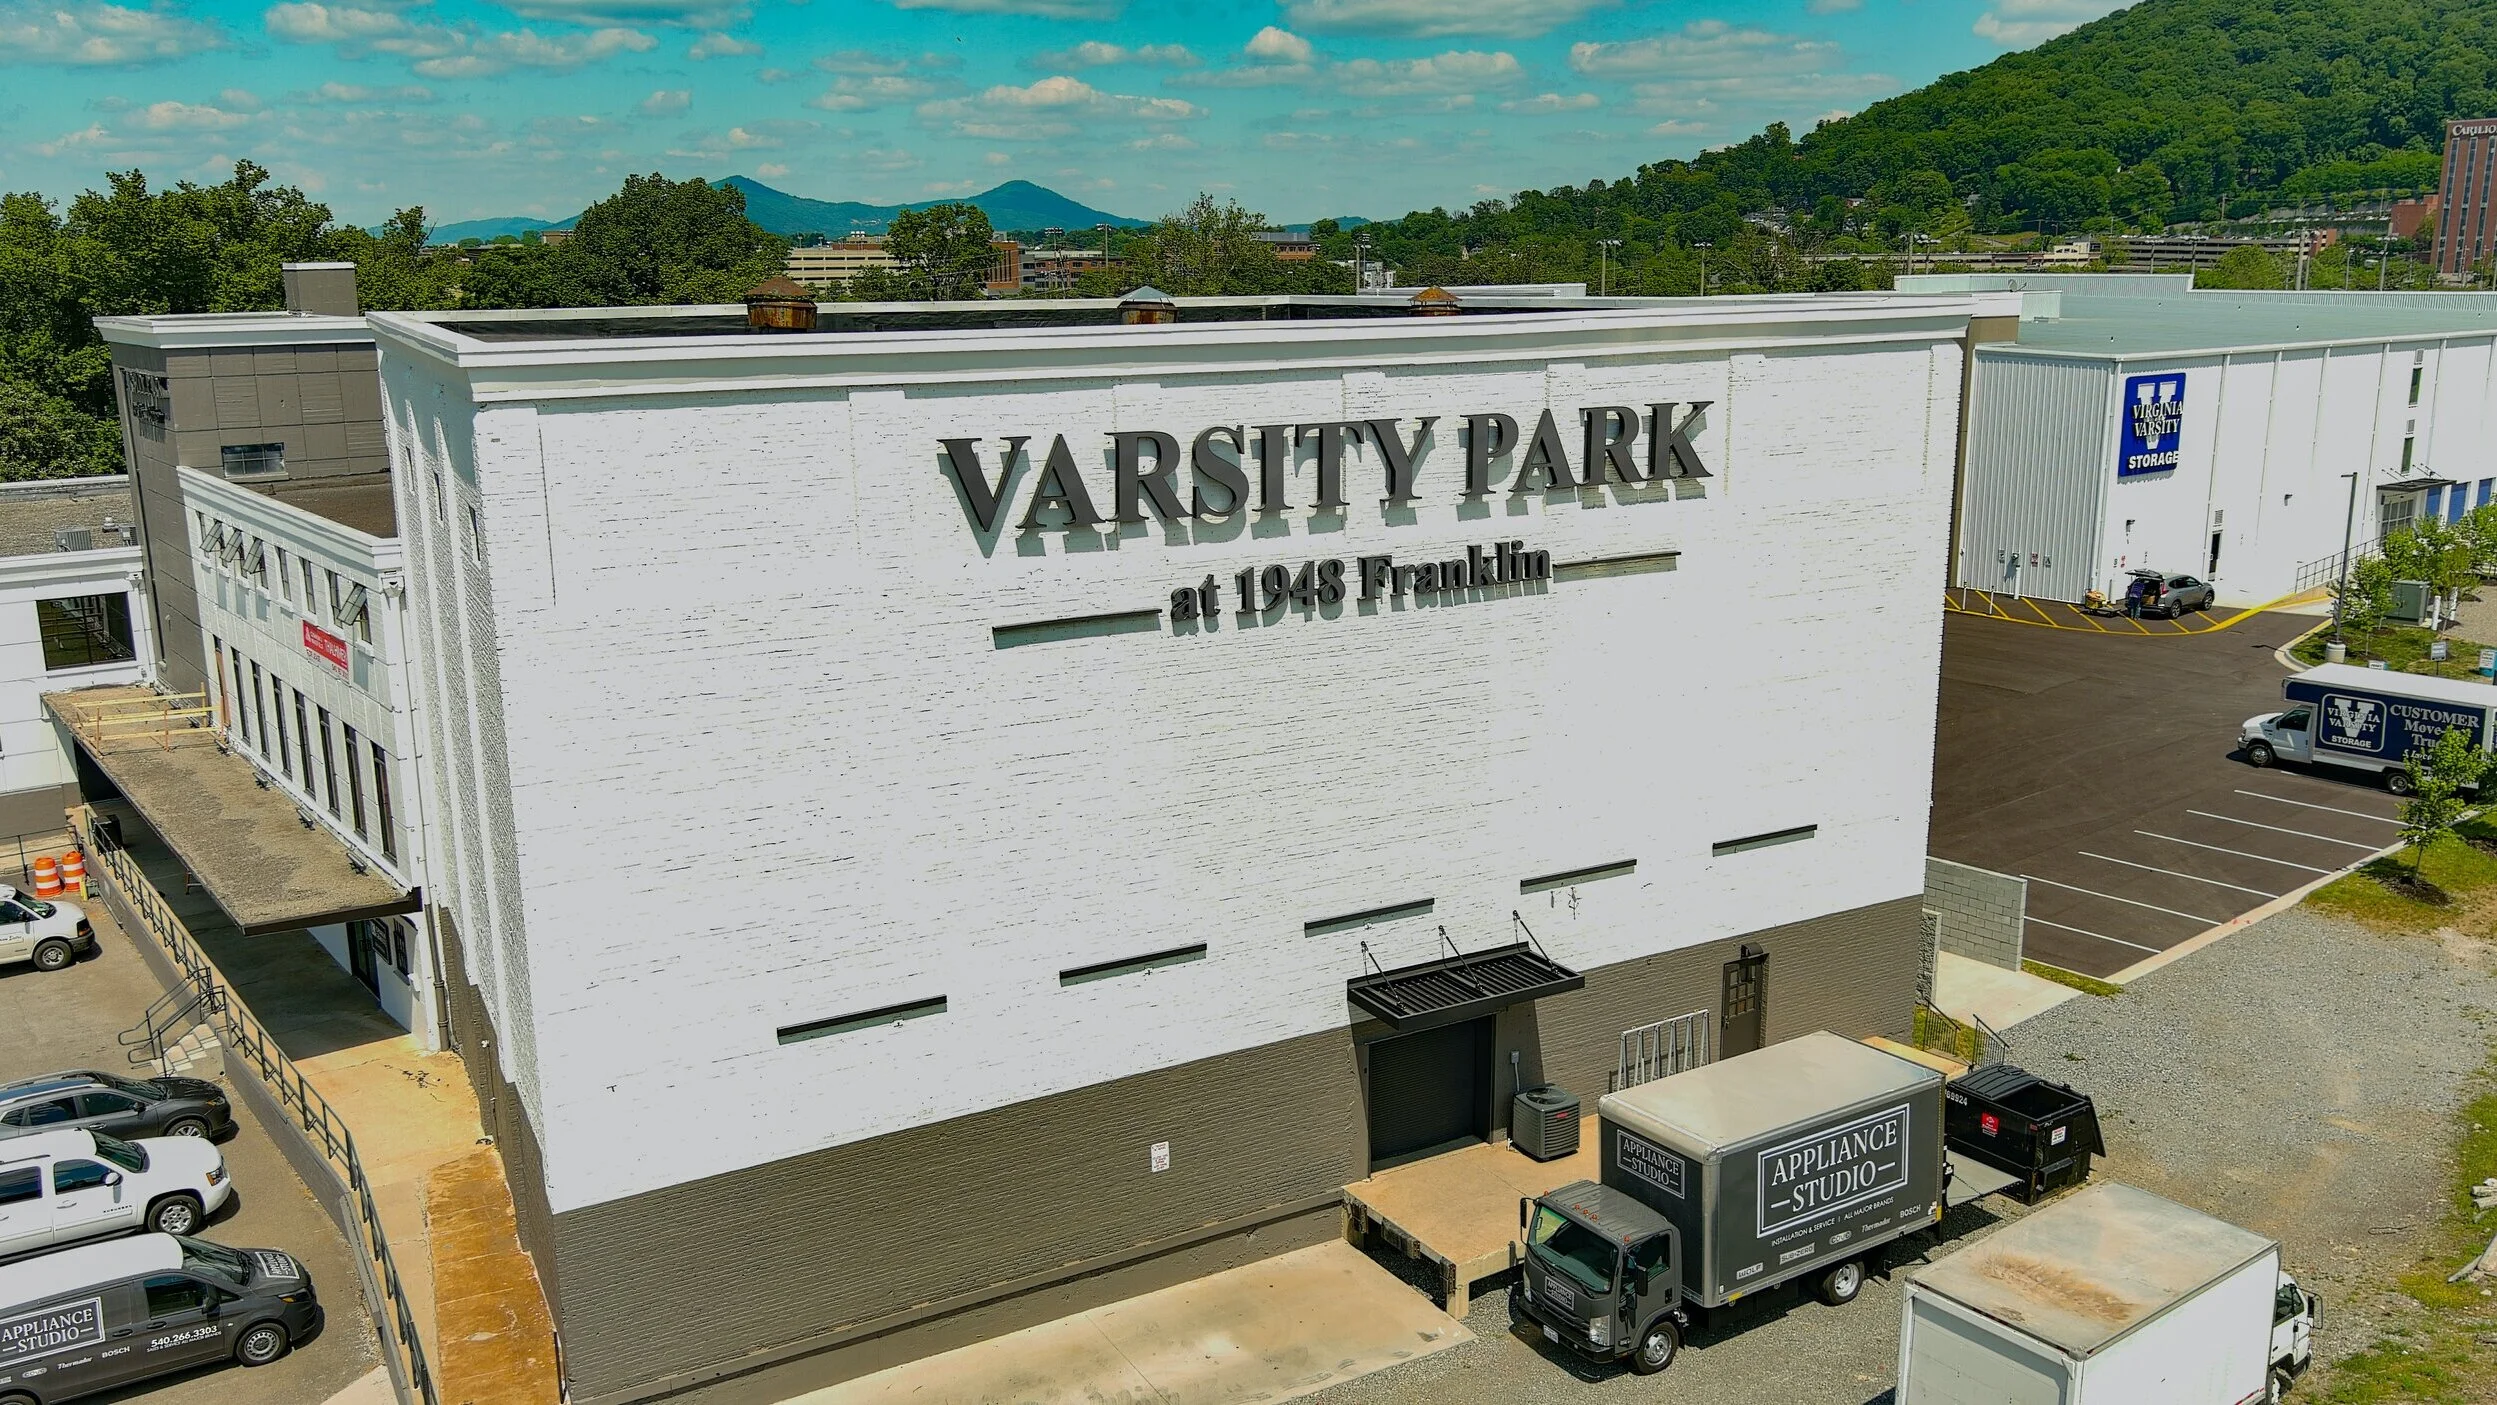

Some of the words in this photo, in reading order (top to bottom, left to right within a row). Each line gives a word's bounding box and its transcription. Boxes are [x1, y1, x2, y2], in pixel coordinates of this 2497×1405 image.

[2452, 124, 2497, 136] CARILIO
[2133, 400, 2183, 419] VIRGINIA
[2134, 419, 2180, 436] VARSITY
[936, 416, 1441, 533] VARSITY
[1460, 400, 1714, 497] PARK
[2128, 450, 2180, 469] STORAGE
[1170, 573, 1221, 621] at
[1235, 559, 1346, 614] 1948
[1357, 540, 1552, 601] Franklin
[2390, 704, 2480, 728] CUSTOMER
[2332, 735, 2372, 748] STORAGE
[1946, 1091, 1968, 1106] 69924
[1624, 1138, 1679, 1176] APPLIANCE
[1771, 1119, 1897, 1187] APPLIANCE
[1632, 1157, 1670, 1185] STUDIO
[1792, 1160, 1876, 1212] STUDIO
[1771, 1228, 1808, 1247] INSTALLATION
[1814, 1218, 1836, 1232] SERVICE
[1854, 1204, 1873, 1218] MAJOR
[1873, 1196, 1894, 1209] BRANDS
[1900, 1204, 1921, 1218] BOSCH
[1862, 1217, 1892, 1233] Thermador
[1548, 1280, 1572, 1300] APPLIANCE
[2, 1308, 93, 1342] APPLIANCE
[18, 1326, 80, 1353] STUDIO
[151, 1326, 218, 1348] 540.266.3303
[102, 1346, 130, 1358] BOSCH
[58, 1357, 92, 1370] Thermador
